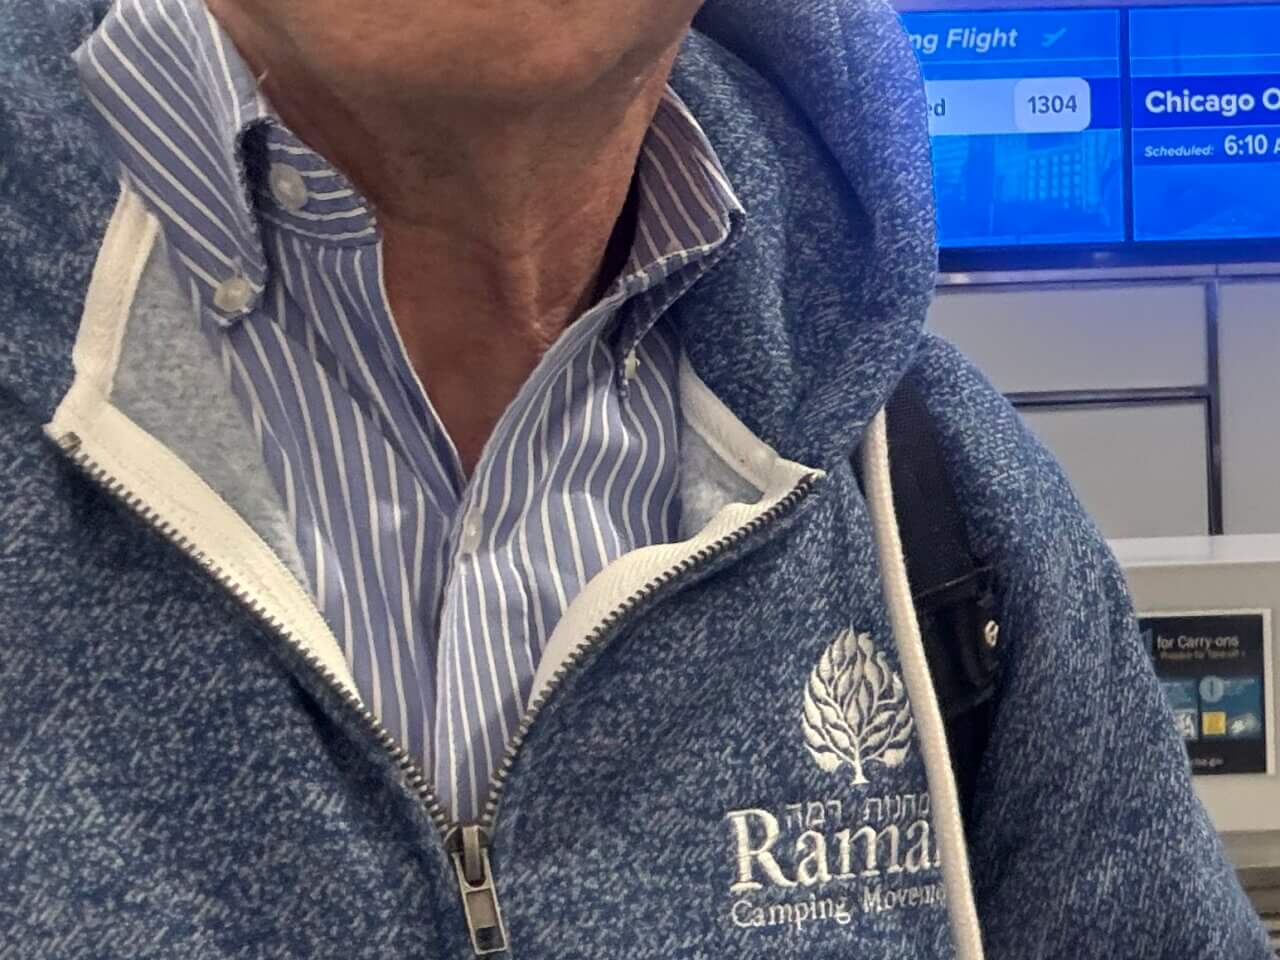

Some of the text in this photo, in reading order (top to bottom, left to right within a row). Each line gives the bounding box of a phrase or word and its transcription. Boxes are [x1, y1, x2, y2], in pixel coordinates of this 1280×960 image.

[946, 27, 1018, 53] Flight
[1027, 95, 1077, 114] 1304
[1145, 89, 1255, 117] Chicago
[1144, 145, 1214, 157] Scheduled:
[1224, 134, 1268, 155] 6:10
[727, 808, 940, 890] Rama
[731, 893, 851, 930] Camping
